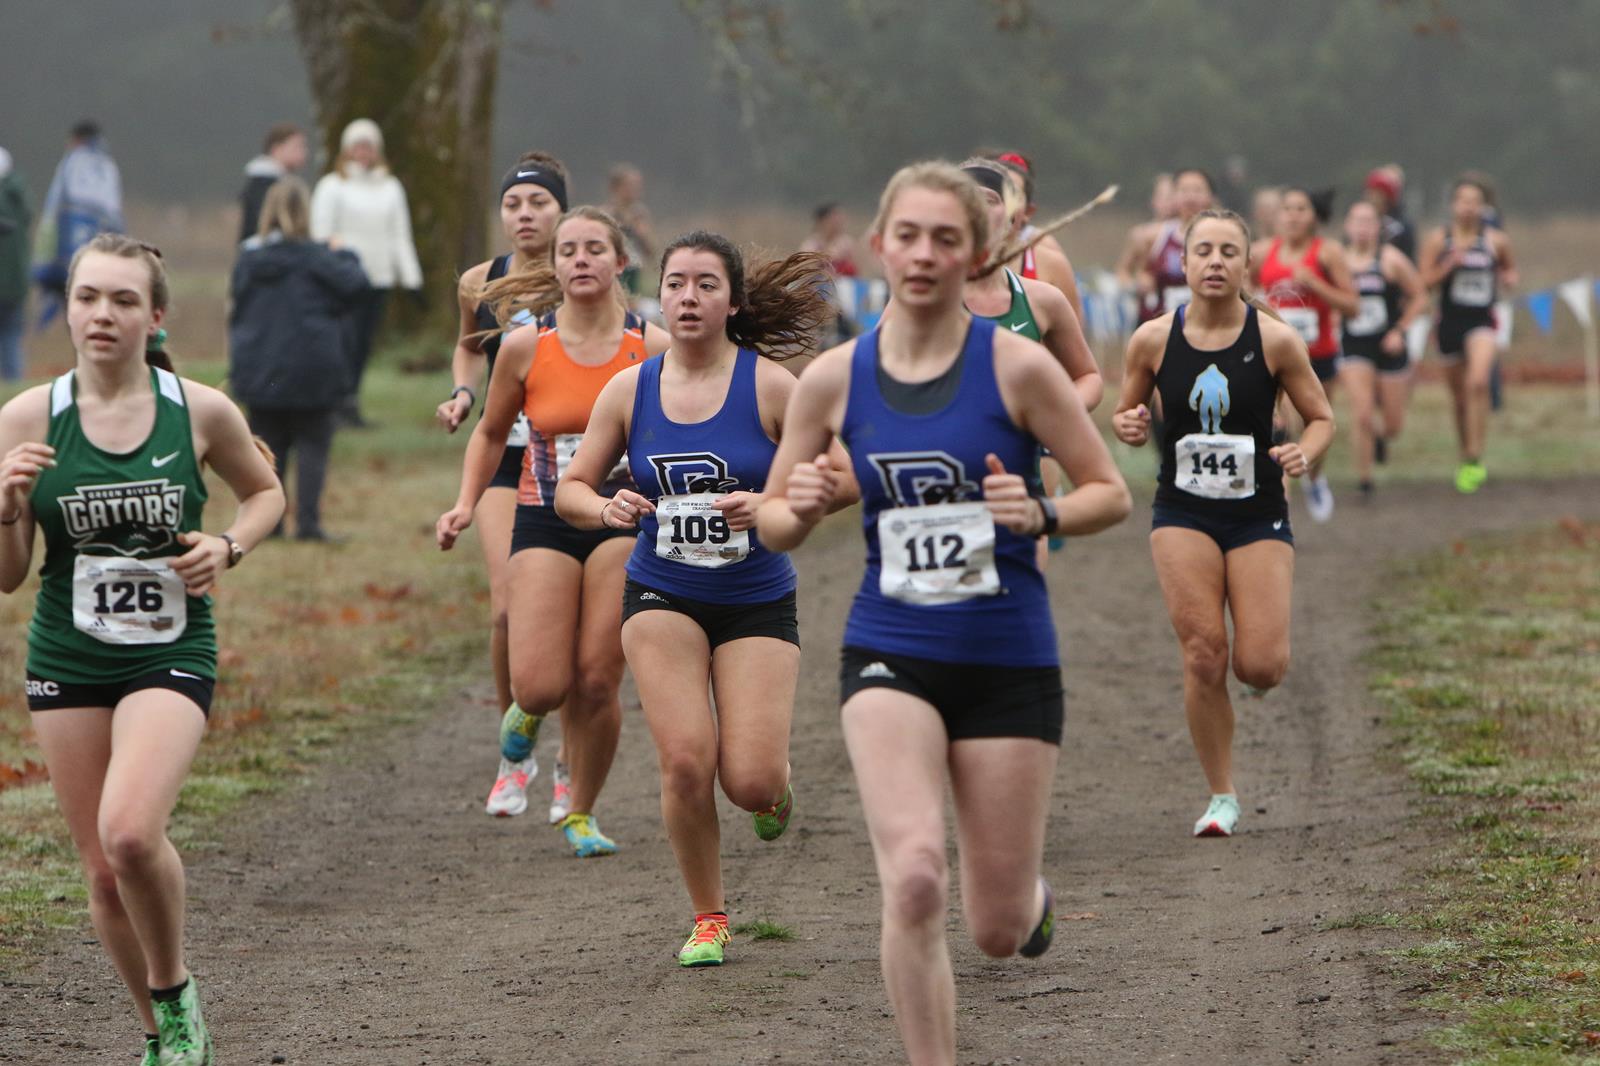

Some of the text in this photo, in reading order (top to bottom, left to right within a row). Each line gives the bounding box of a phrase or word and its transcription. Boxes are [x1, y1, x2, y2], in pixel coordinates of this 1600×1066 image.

[1191, 452, 1238, 476] 144
[67, 491, 179, 533] GATORS
[670, 515, 731, 544] 109
[904, 534, 967, 572] 112
[93, 581, 163, 614] 126
